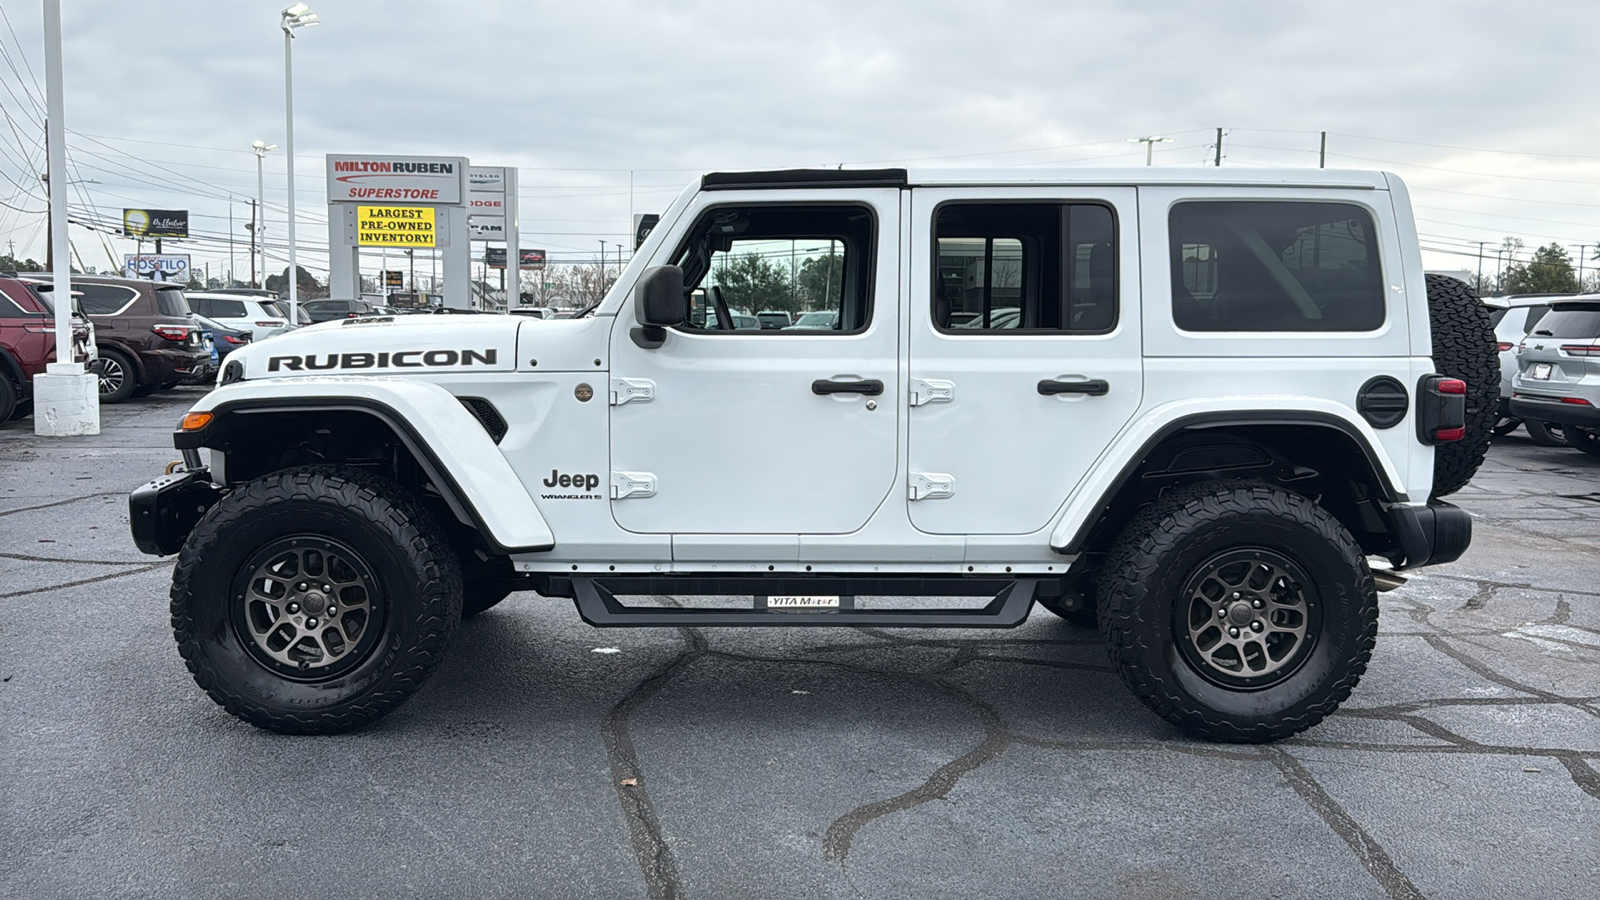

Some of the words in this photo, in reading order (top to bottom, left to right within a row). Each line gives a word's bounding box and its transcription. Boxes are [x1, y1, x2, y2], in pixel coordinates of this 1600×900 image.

[334, 161, 391, 172] MILTON
[392, 162, 453, 174] RUBEN
[348, 187, 440, 199] SUPERSTORE
[369, 208, 424, 219] LARGEST
[360, 220, 433, 230] PRE-OWNED
[360, 232, 434, 243] INVENTORY!
[128, 260, 187, 270] HOSTILO
[267, 348, 498, 373] RUBICON
[543, 469, 599, 492] Jeep
[773, 597, 798, 606] YITA
